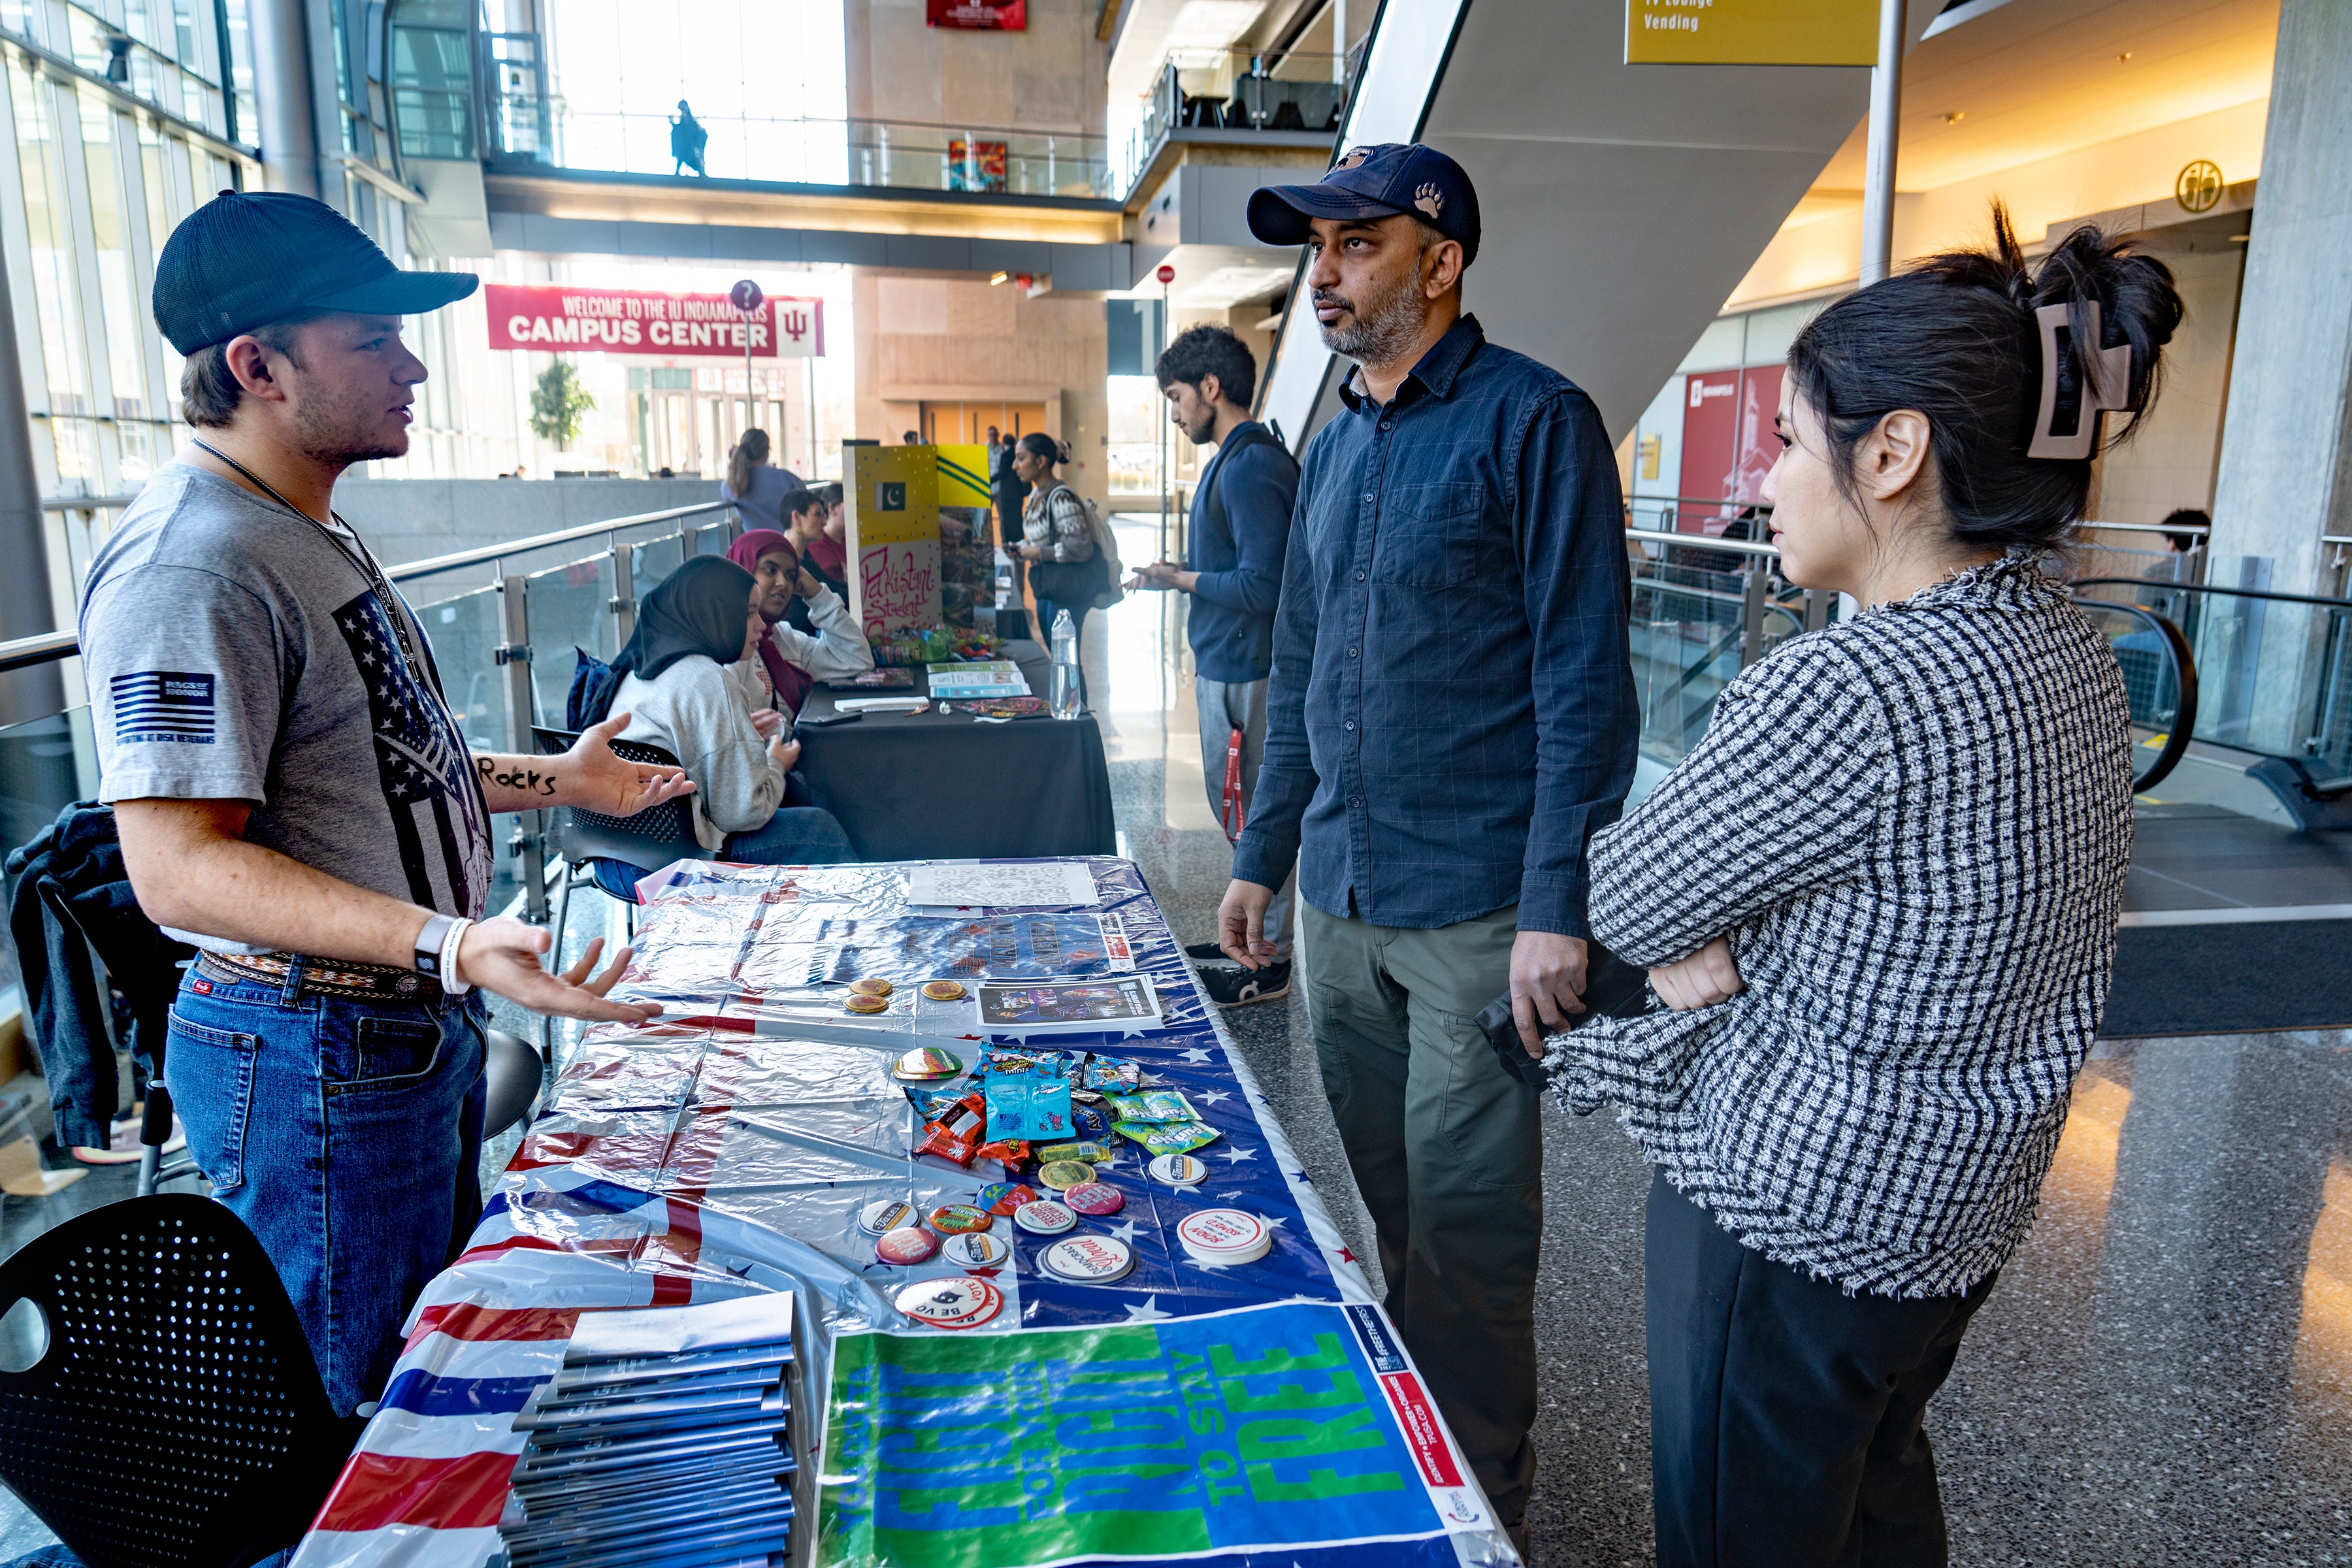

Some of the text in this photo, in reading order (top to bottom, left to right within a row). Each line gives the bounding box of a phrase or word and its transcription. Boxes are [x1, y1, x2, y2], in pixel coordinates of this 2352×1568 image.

[1644, 13, 1699, 32] Vending
[562, 295, 624, 319] WELCOME
[625, 297, 642, 319] TO
[642, 299, 666, 320] THE
[668, 300, 681, 321] IU
[508, 315, 768, 348] CAMPUS CENTER
[860, 545, 934, 606] Pakistani
[863, 593, 924, 620] Student
[165, 689, 210, 697] HONOR
[157, 733, 175, 742] RISK
[176, 734, 216, 744] VETERANS
[989, 923, 1019, 968] MADE IN
[1029, 922, 1062, 966] AMERICA
[1129, 990, 1145, 1015] TPUSA EVENTS
[1175, 1125, 1204, 1142] Fun
[1171, 1159, 1183, 1177] Taxes
[875, 1207, 900, 1226] Taxes
[1026, 1205, 1060, 1227] FREEDOM
[1037, 1201, 1071, 1222] SECURED
[1205, 1219, 1244, 1236] ARMED
[1188, 1228, 1225, 1243] BORN
[1059, 1243, 1103, 1275] DEMOCRACY
[966, 1282, 982, 1301] VOTE
[941, 1307, 961, 1316] BE
[1356, 1305, 1390, 1357] #FREETHEFIRST
[1388, 1375, 1409, 1407] ORGANIZE
[1170, 1348, 1245, 1507] TO STAY
[1207, 1331, 1406, 1503] FREE
[1405, 1409, 1427, 1446] EMPOWER
[1414, 1404, 1437, 1445] TPUSA.COM
[838, 1364, 873, 1536] YOU GOTTA
[874, 1363, 1019, 1531] FIGHT
[1013, 1360, 1056, 1522] FOR YOUR
[1045, 1358, 1203, 1515] RIGHT
[1422, 1450, 1445, 1484] IDENTIFY
